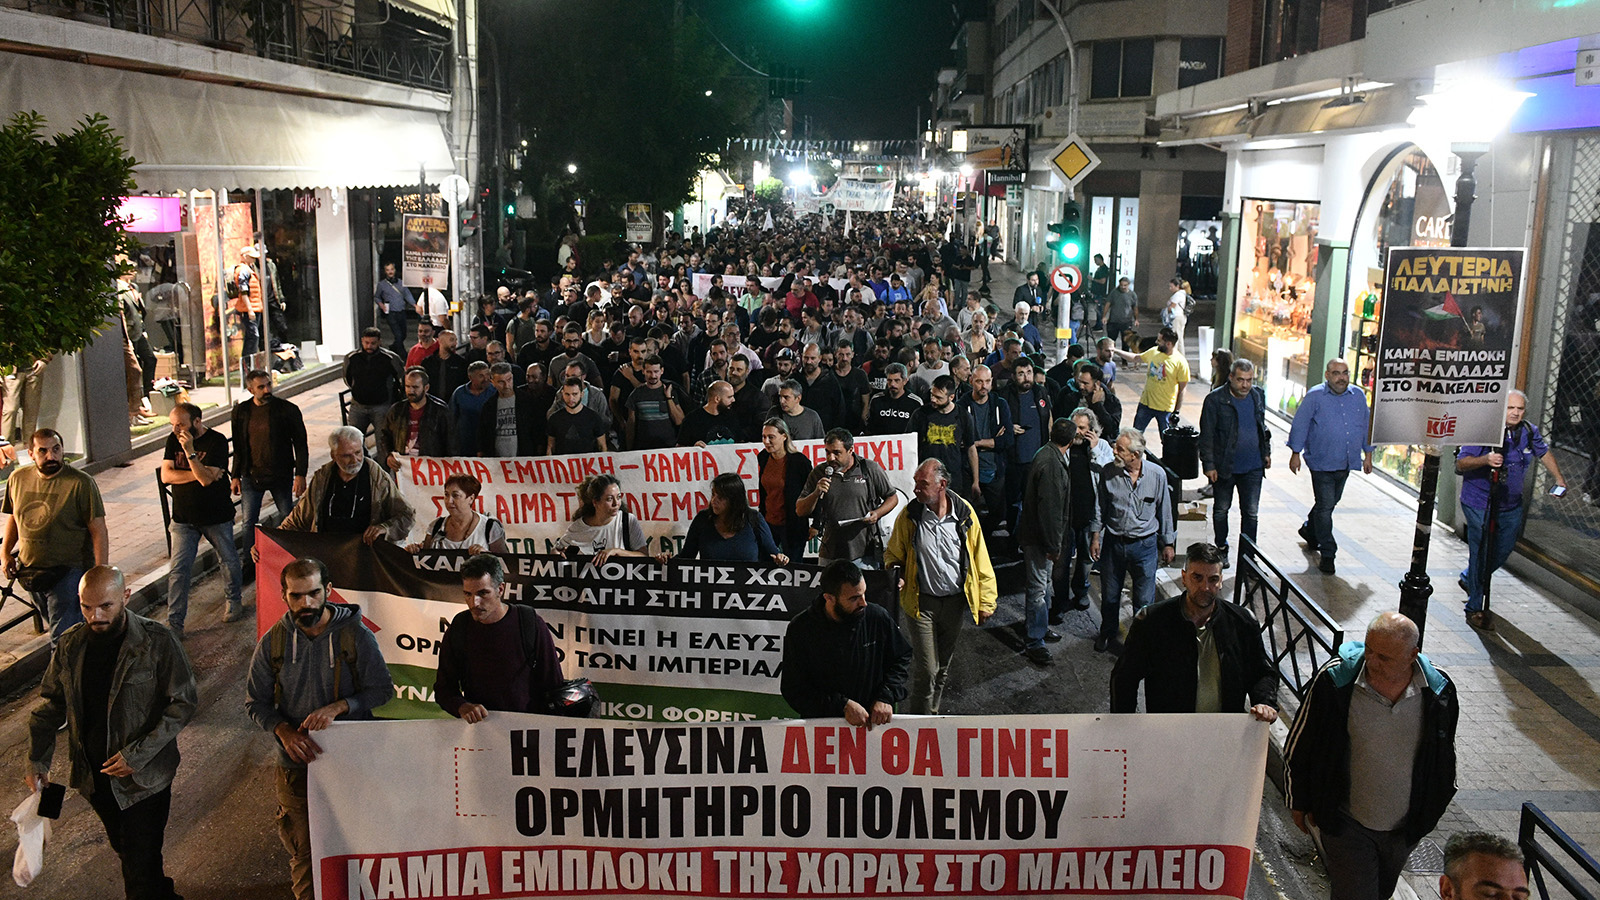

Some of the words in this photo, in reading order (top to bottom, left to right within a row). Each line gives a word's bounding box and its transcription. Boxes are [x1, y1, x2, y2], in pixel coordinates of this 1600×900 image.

[991, 174, 1021, 182] Hannibal
[1123, 207, 1133, 276] Hanniba
[1395, 256, 1514, 277] ΛΕΥΤΕΡΙΑ
[1391, 276, 1514, 295] ΠΑΛΑΙΣΤΙΝΗ
[1384, 347, 1432, 361] ΚΑΜΙΑ
[1435, 350, 1506, 362] ΕΜΠΛΟΚΗ
[1383, 363, 1416, 376] ΤΗΣ
[1419, 363, 1505, 378] ΕΛΛΑΔΑΣ
[1381, 379, 1412, 393] ΣΤΟ
[1416, 380, 1501, 395] ΜΑΚΕΛΕΙΟ
[879, 408, 910, 419] adidas
[410, 457, 493, 486] ΚΑΜΙΑ
[500, 456, 615, 484] ΕΜΠΛΟΚΗ
[641, 450, 719, 482] ΚΑΜΙΑ
[495, 490, 709, 524] ΑΙΜΑΤΛΙΣΜΑ
[518, 557, 668, 583] ΕΜΠΛΟΚΗ
[678, 565, 735, 585] ΤΗΣ
[744, 567, 823, 588] ΧΩΡΑ
[533, 584, 635, 607] ΣΦΑΓΗ
[645, 589, 701, 609] ΣΤΗ
[712, 592, 788, 612] ΓΑΖΑ
[575, 626, 645, 647] ΓΙΝΕΙ
[657, 630, 677, 648] Η
[689, 631, 781, 652] ΕΛΕΥΣ
[575, 650, 637, 671] ΤΩΝ
[510, 729, 541, 777] Η
[554, 726, 769, 778] ΕΛΕΥΣΙΝΑ
[780, 726, 867, 775] ΔΕΝ
[880, 727, 944, 776] ΘΑ
[956, 728, 1070, 778] ΓΙΝΕΙ
[515, 784, 812, 839] ΟΡΜΗΤΗΡΙΟ
[826, 786, 1069, 840] ΠΟΛΕΜΟΥ
[347, 851, 491, 900] ΚΑΜΙΑ
[501, 849, 702, 894] ΕΜΠΛΟΚΗ
[713, 850, 788, 894] ΤΗΣ
[797, 850, 925, 894] ΧΩΡΑΣ
[934, 853, 1006, 892] ΣΤΟ
[1017, 848, 1226, 893] ΜΑΚΕΛΕΙΟ
